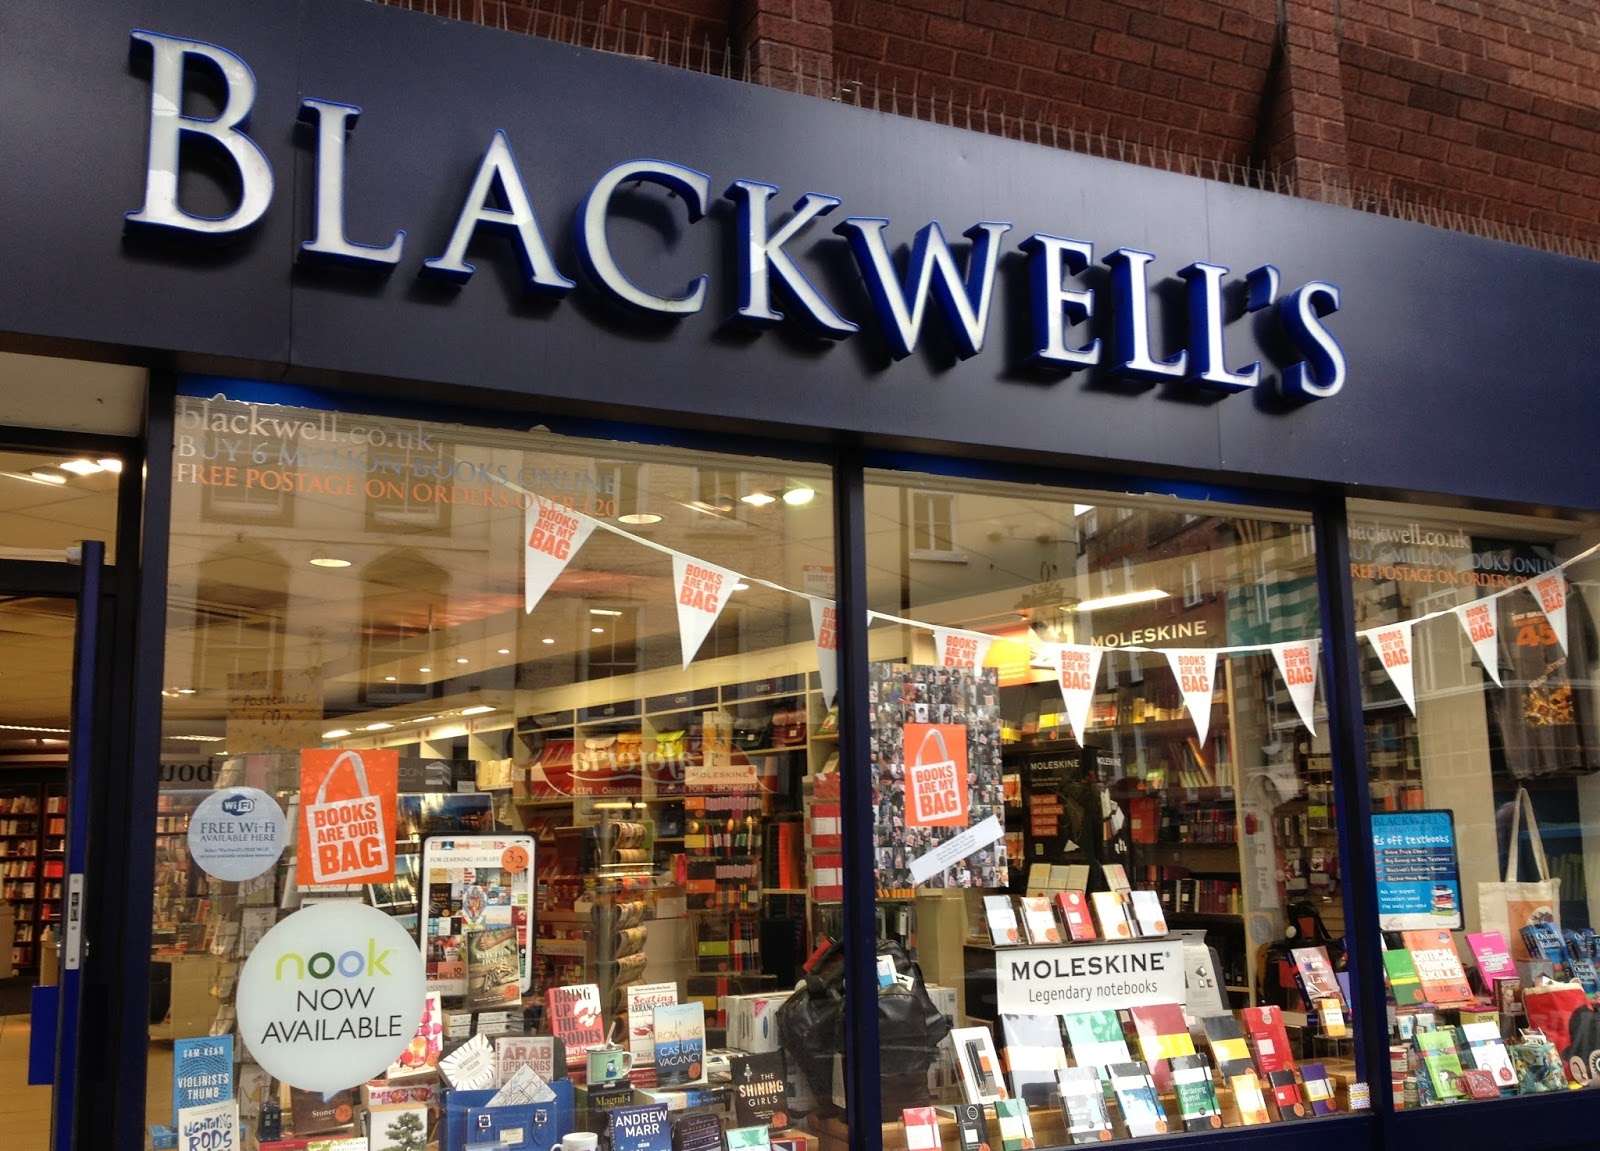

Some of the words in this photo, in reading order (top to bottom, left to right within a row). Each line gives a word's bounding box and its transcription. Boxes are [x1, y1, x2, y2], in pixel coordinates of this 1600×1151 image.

[124, 29, 1348, 400] BLACKWELL'S
[178, 398, 435, 452] blackwell.co.uk
[178, 435, 242, 462] BUY
[252, 442, 268, 464] 6
[277, 441, 402, 476] MILLION
[412, 456, 509, 484] BOOKS
[176, 463, 239, 489] FREE
[246, 468, 359, 498] POSTAGE
[365, 479, 406, 500] ON
[412, 483, 509, 511] ORDERS
[539, 506, 579, 530] BOOKS
[535, 518, 557, 535] ARE
[557, 526, 575, 541] MY
[1348, 520, 1471, 549] lackwell.co.uk
[528, 528, 573, 561] BAG
[1513, 556, 1563, 574] ONLIN
[685, 564, 723, 585] BOOKS
[1350, 563, 1375, 579] REE
[1378, 565, 1434, 583] POSTAGE
[1437, 570, 1459, 585] ON
[1462, 572, 1513, 588] ORDERS
[683, 576, 702, 590] ARE
[703, 582, 721, 595] MY
[679, 586, 720, 614] BAG
[1543, 593, 1564, 614] BAG
[1466, 604, 1489, 618] BOOKS
[1090, 620, 1208, 649] MOLESKINE
[1378, 630, 1404, 645] BOOKS
[1471, 622, 1494, 642] BAG
[946, 636, 978, 650] BOOKS
[946, 648, 962, 660] ARE
[962, 650, 976, 660] MY
[1061, 650, 1090, 662] BOOKS
[1178, 655, 1206, 666] BOOKS
[1283, 647, 1310, 659] BOOKS
[1383, 648, 1410, 669] BAG
[1062, 661, 1077, 672] ARE
[1077, 662, 1090, 672] MY
[1180, 665, 1194, 675] ARE
[1195, 665, 1206, 675] MY
[1062, 671, 1091, 690] BAG
[1181, 675, 1210, 693] BAG
[1286, 666, 1314, 686] BAG
[1030, 759, 1080, 771] MOLESKINE
[691, 770, 749, 780] MOLESKINE
[915, 765, 954, 783] BOOKS
[918, 781, 938, 795] ARE
[939, 778, 955, 792] MY
[919, 790, 959, 818] BAG
[314, 802, 377, 828] BOOKS
[201, 822, 234, 834] FREE
[239, 821, 276, 833] Wi-Fi
[317, 827, 349, 844] ARE
[350, 821, 379, 837] OUR
[200, 834, 249, 843] AVAILABLE
[251, 834, 276, 842] HERE
[1387, 835, 1402, 845] off
[1405, 834, 1449, 844] textbooks
[318, 837, 383, 876] BAG
[1536, 930, 1558, 942] Oxford
[1540, 938, 1561, 949] Italian
[275, 938, 392, 980] nook
[1011, 952, 1166, 981] MOLESKINE
[1310, 975, 1328, 984] Law
[1421, 968, 1464, 980] SKILLS
[297, 987, 375, 1012] NOW
[554, 987, 591, 1001] BRING
[633, 994, 673, 1004] Seating
[1029, 984, 1092, 1005] Legendary
[1097, 980, 1158, 998] notebooks
[556, 1004, 571, 1018] UP
[261, 1015, 402, 1044] AVAILABLE
[557, 1017, 578, 1031] THE
[559, 1029, 601, 1046] BODIES
[658, 1027, 701, 1039] ROWNG
[183, 1048, 200, 1058] SAM
[204, 1046, 224, 1056] KEAN
[503, 1047, 551, 1060] ARAB
[658, 1053, 701, 1067] VACANCY
[760, 1072, 775, 1080] THE
[188, 1087, 219, 1100] THUMB
[739, 1080, 784, 1098] SHINING
[748, 1095, 779, 1107] GIRLS
[312, 1109, 336, 1117] Stoner
[615, 1110, 668, 1127] ANDREW
[184, 1114, 232, 1137] LIGHTNING
[625, 1123, 660, 1138] MARR
[189, 1130, 233, 1151] RODS
